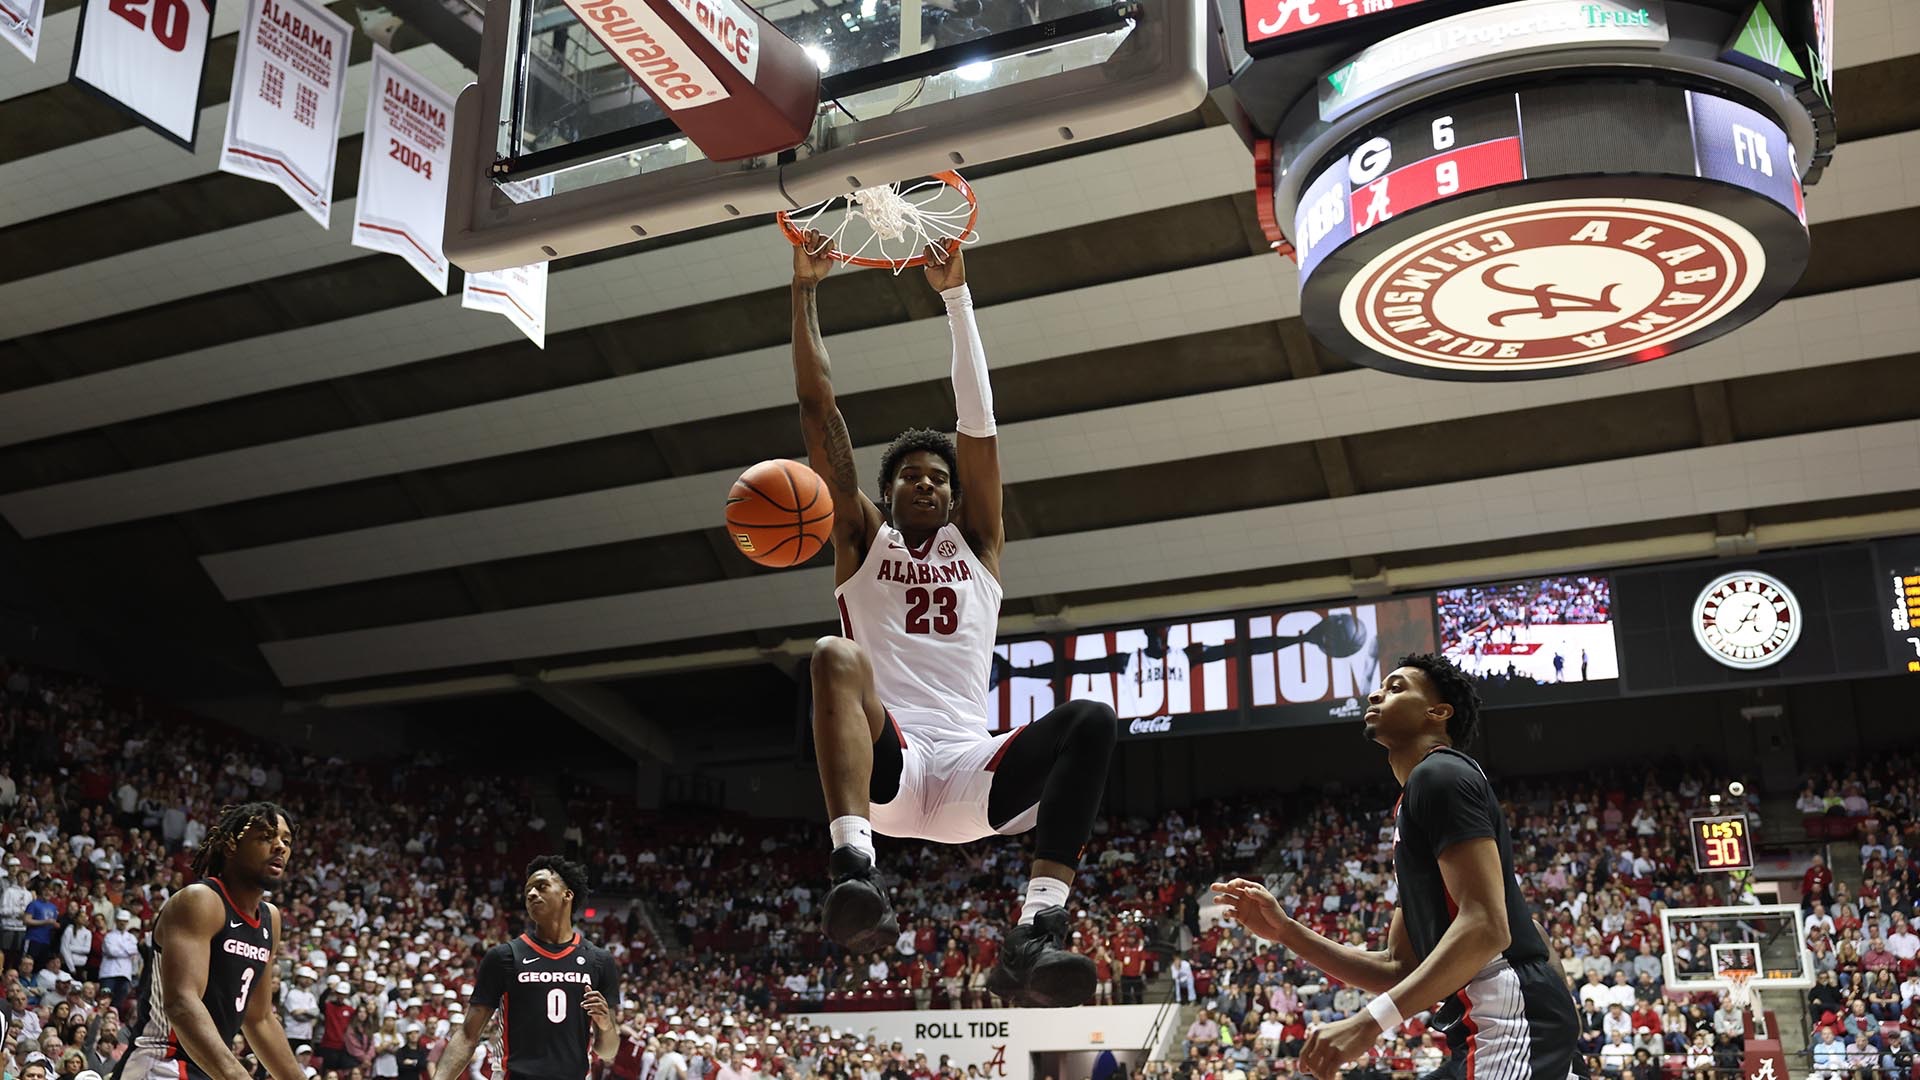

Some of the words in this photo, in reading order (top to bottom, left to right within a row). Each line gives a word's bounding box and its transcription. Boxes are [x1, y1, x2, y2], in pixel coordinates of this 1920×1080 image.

[262, 0, 332, 60] ALABAMA
[680, 0, 750, 64] ance
[1581, 4, 1650, 27] Trust
[385, 77, 446, 132] ALABAMA
[389, 138, 432, 180] 2004
[1349, 136, 1392, 185] G
[1432, 116, 1455, 150] 6
[1733, 123, 1773, 177] FT%
[1436, 160, 1459, 195] 9
[1383, 230, 1515, 333] CRIMSON
[1570, 220, 1717, 347] ALABAMA
[1414, 329, 1525, 358] TIDE
[938, 540, 957, 558] SEC
[877, 559, 973, 585] ALABAMA
[905, 586, 958, 635] 23
[1702, 821, 1743, 839] 11:57
[1705, 837, 1741, 866] 30
[235, 967, 255, 1013] 3
[518, 971, 592, 985] GEORGIA
[547, 988, 567, 1024] 0
[915, 1023, 963, 1039] ROLL
[968, 1022, 1009, 1038] TIDE
